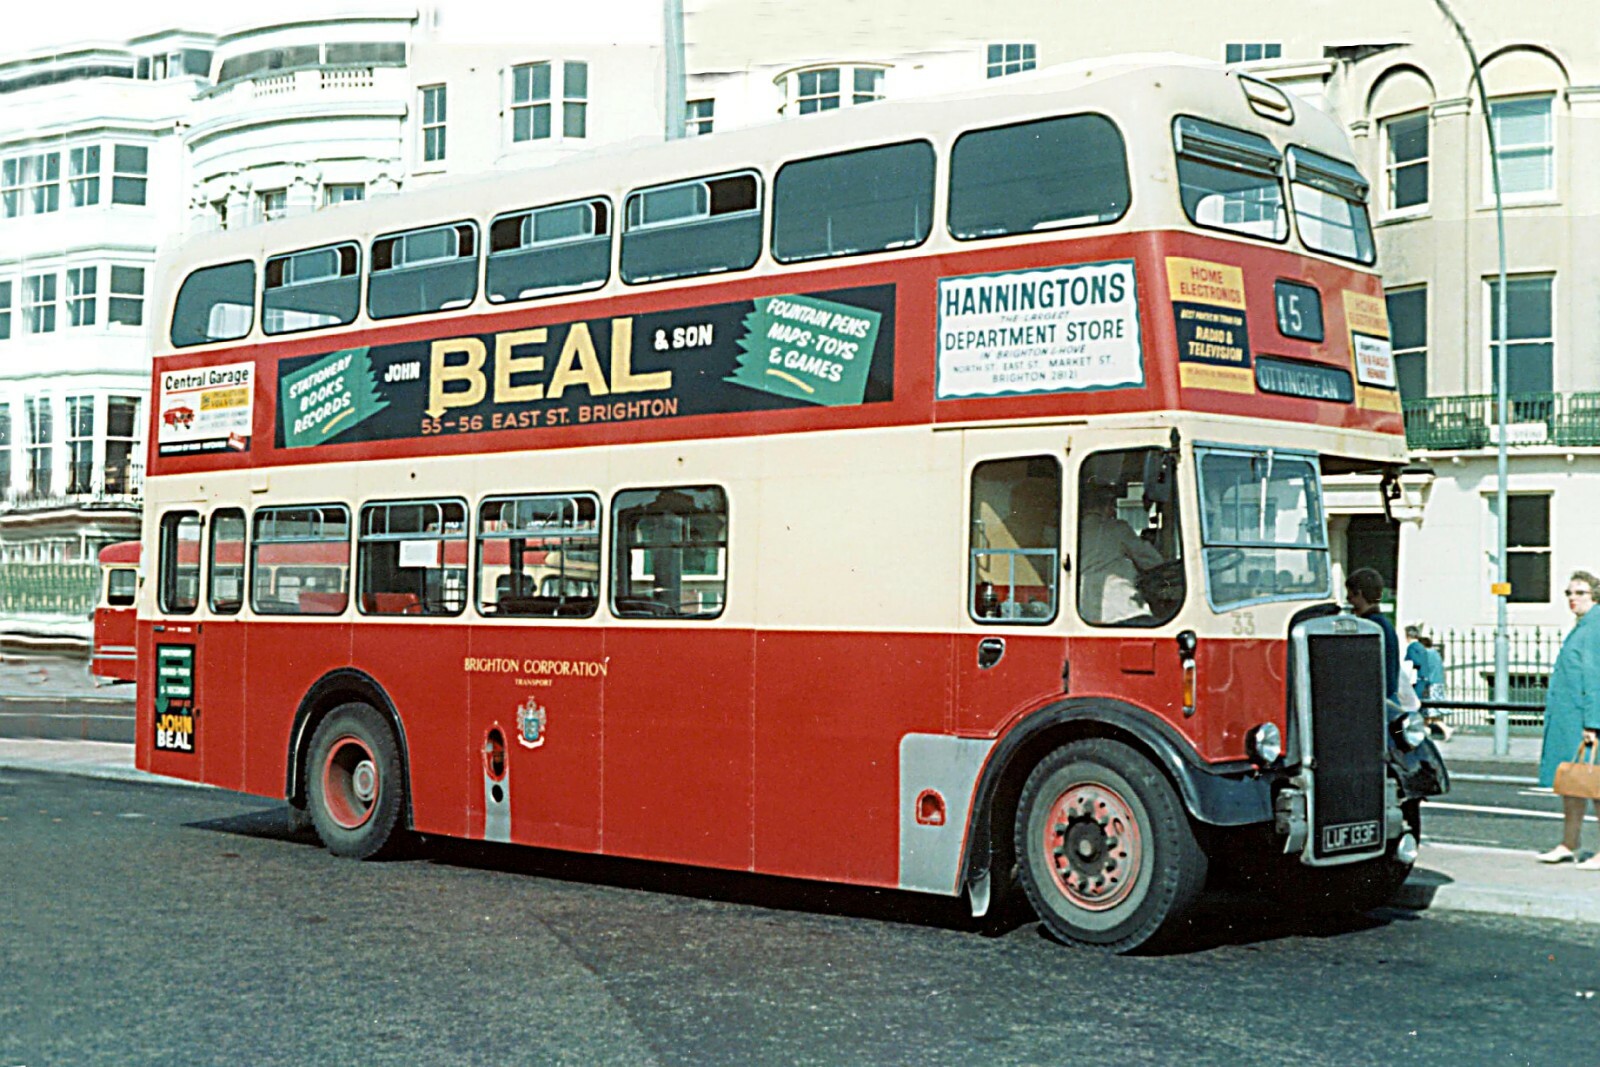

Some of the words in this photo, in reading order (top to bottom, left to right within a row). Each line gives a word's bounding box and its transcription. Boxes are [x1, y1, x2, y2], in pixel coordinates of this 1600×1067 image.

[1191, 266, 1224, 285] HOME
[945, 273, 1125, 316] HANNINGTONS
[1180, 281, 1242, 304] ELECTRONICS
[766, 298, 831, 328] FOUNTAIN
[829, 314, 871, 338] PENS
[654, 329, 669, 350] &
[673, 324, 713, 348] SON
[945, 324, 1057, 351] DEPARTMENT
[1066, 319, 1124, 342] STORE
[1195, 325, 1225, 344] RADIO
[996, 346, 1048, 360] BRIGHTON
[1188, 341, 1243, 361] TELEVISION
[384, 361, 420, 382] JOHN
[426, 317, 672, 414] BEAL
[784, 350, 843, 382] GAMES
[953, 364, 982, 373] NORTH
[1003, 361, 1024, 371] EAST
[1049, 356, 1092, 367] MARKET
[165, 371, 206, 390] Central
[209, 369, 249, 386] Garage
[289, 354, 352, 399] STATIONERY
[992, 371, 1046, 383] BRIGHTON
[300, 376, 345, 412] BOOKS
[294, 391, 352, 435] RECORDS
[492, 410, 541, 430] EAST
[546, 407, 570, 425] ST.
[579, 398, 678, 422] BRIGHTON
[1231, 611, 1255, 635] 33
[464, 657, 519, 673] BRIGHTON
[523, 659, 608, 677] CORPORATION
[515, 678, 553, 687] TRANSPORT
[156, 713, 192, 734] JOHN
[157, 729, 192, 750] BEAL
[1326, 827, 1349, 848] LUF
[1351, 824, 1376, 845] 133F
